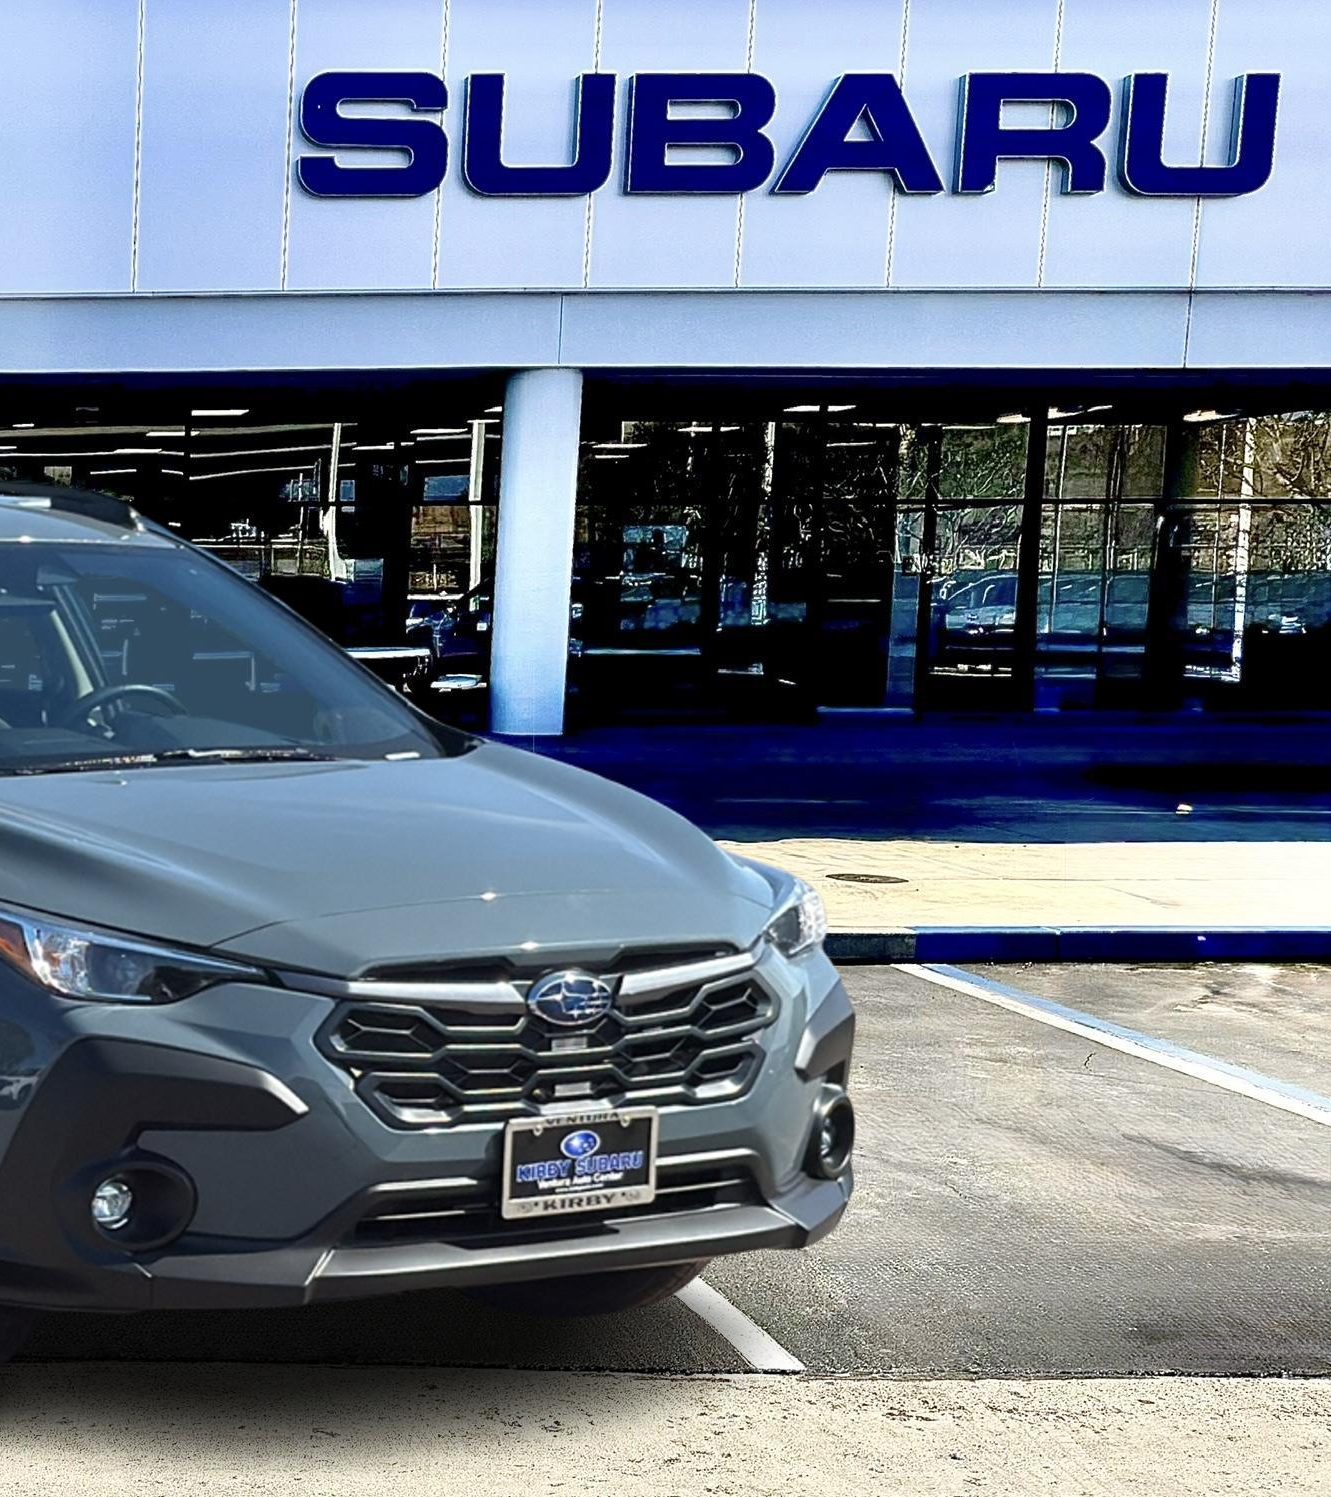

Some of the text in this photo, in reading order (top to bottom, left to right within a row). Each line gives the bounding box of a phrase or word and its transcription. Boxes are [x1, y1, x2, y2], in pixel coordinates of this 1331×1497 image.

[297, 71, 1281, 197] SUBARU
[545, 1111, 619, 1125] VENTURA
[516, 1151, 644, 1182] KIRBY SUBARU
[572, 1174, 592, 1185] Auto
[593, 1171, 624, 1182] Center
[542, 1193, 616, 1211] KIRBY
